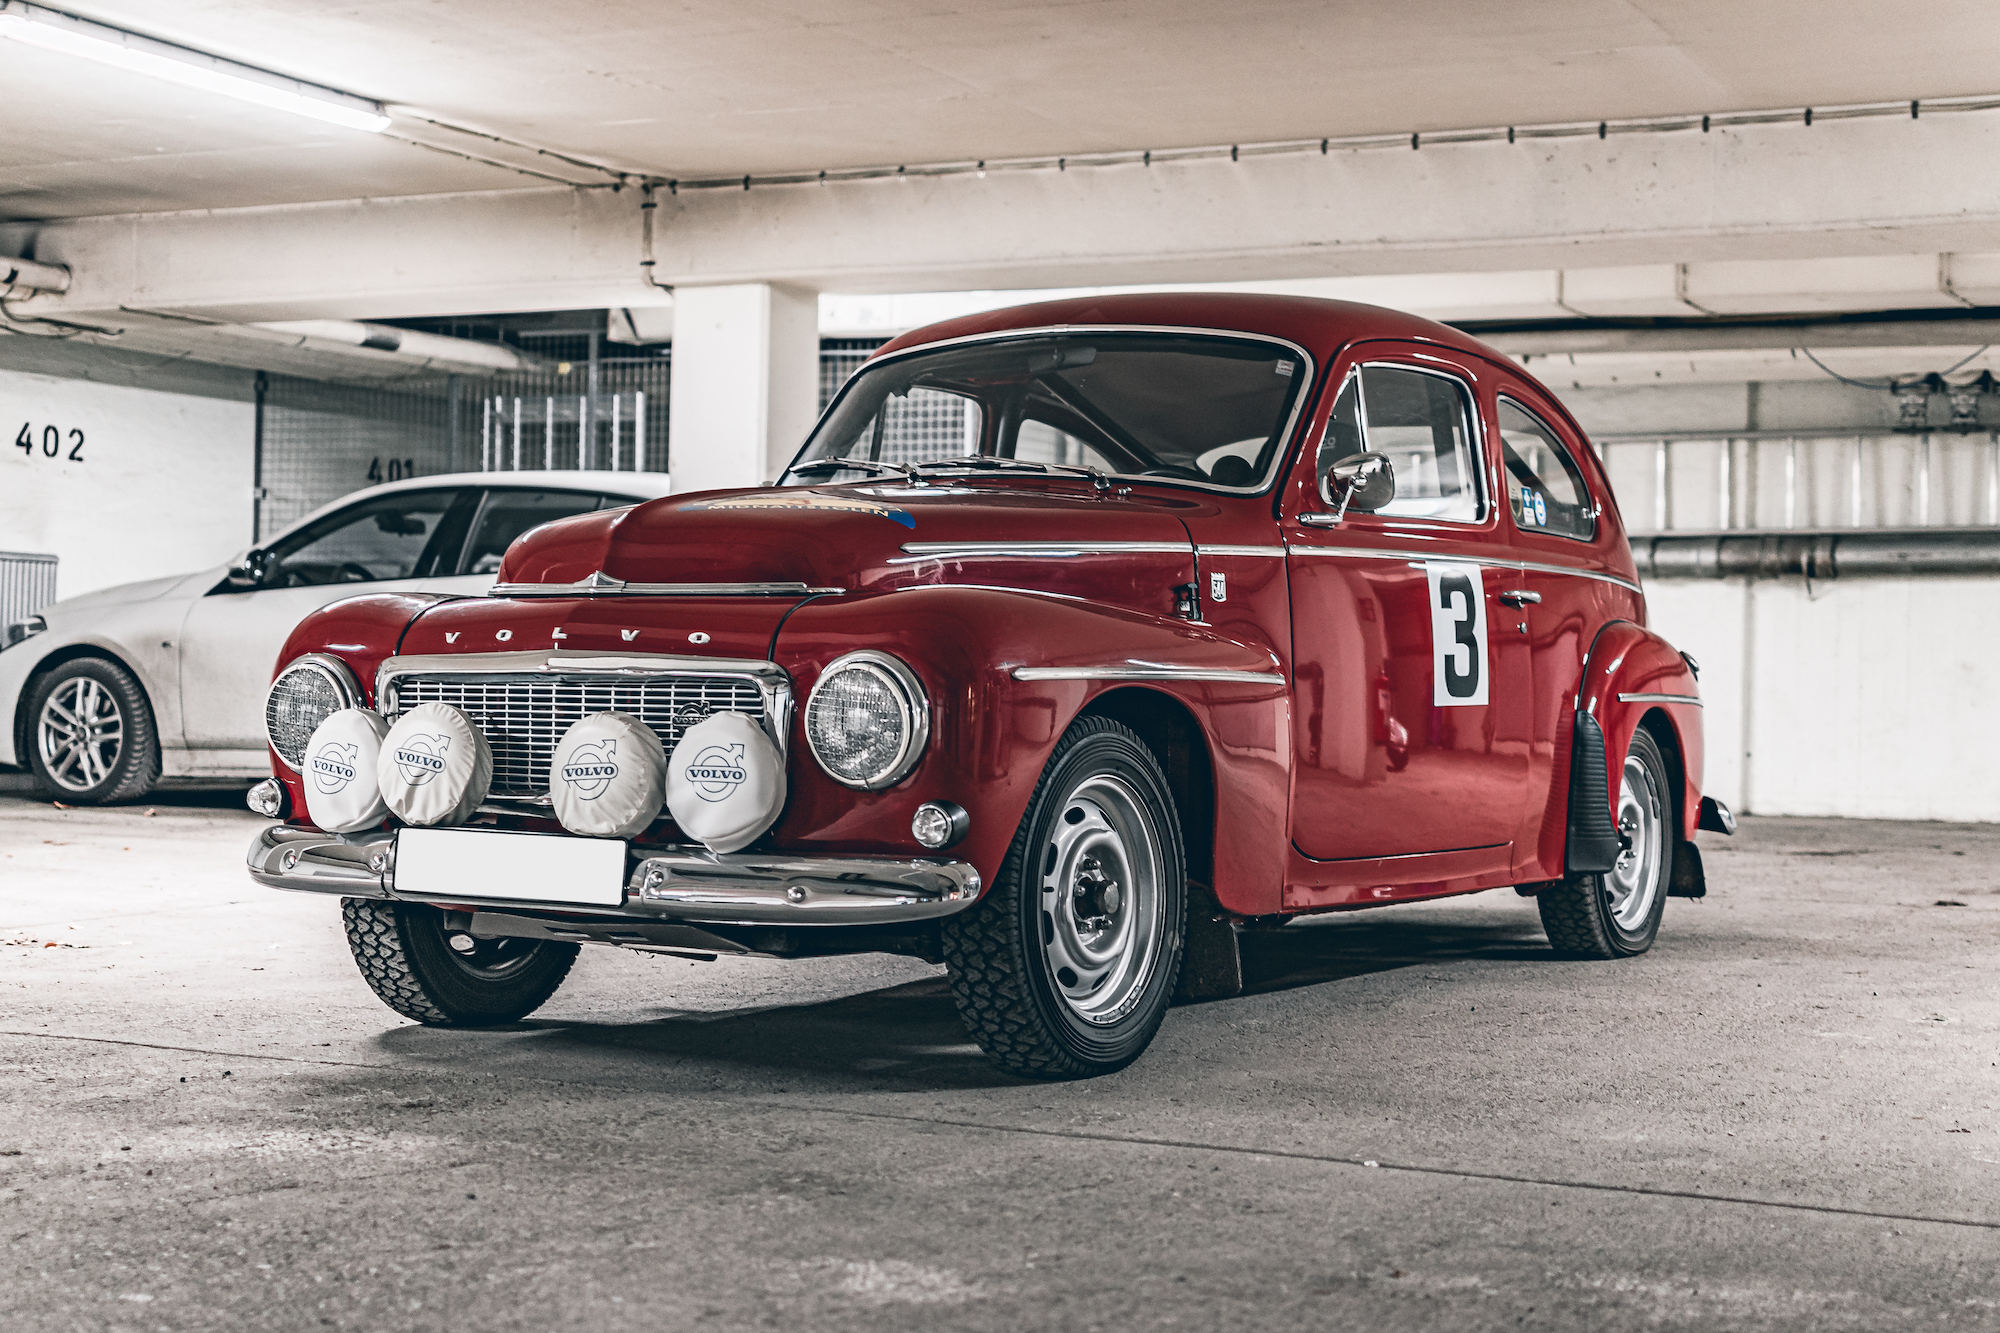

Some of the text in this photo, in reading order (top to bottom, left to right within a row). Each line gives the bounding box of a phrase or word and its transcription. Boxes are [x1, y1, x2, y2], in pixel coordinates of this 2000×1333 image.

[15, 421, 85, 462] 402
[367, 456, 414, 484] 401
[444, 626, 712, 645] VOLVO
[1439, 568, 1480, 698] 3
[313, 760, 353, 778] VOLVO
[397, 751, 443, 770] VOLVO
[564, 766, 615, 777] VOLVO
[689, 769, 743, 780] VOLVO
